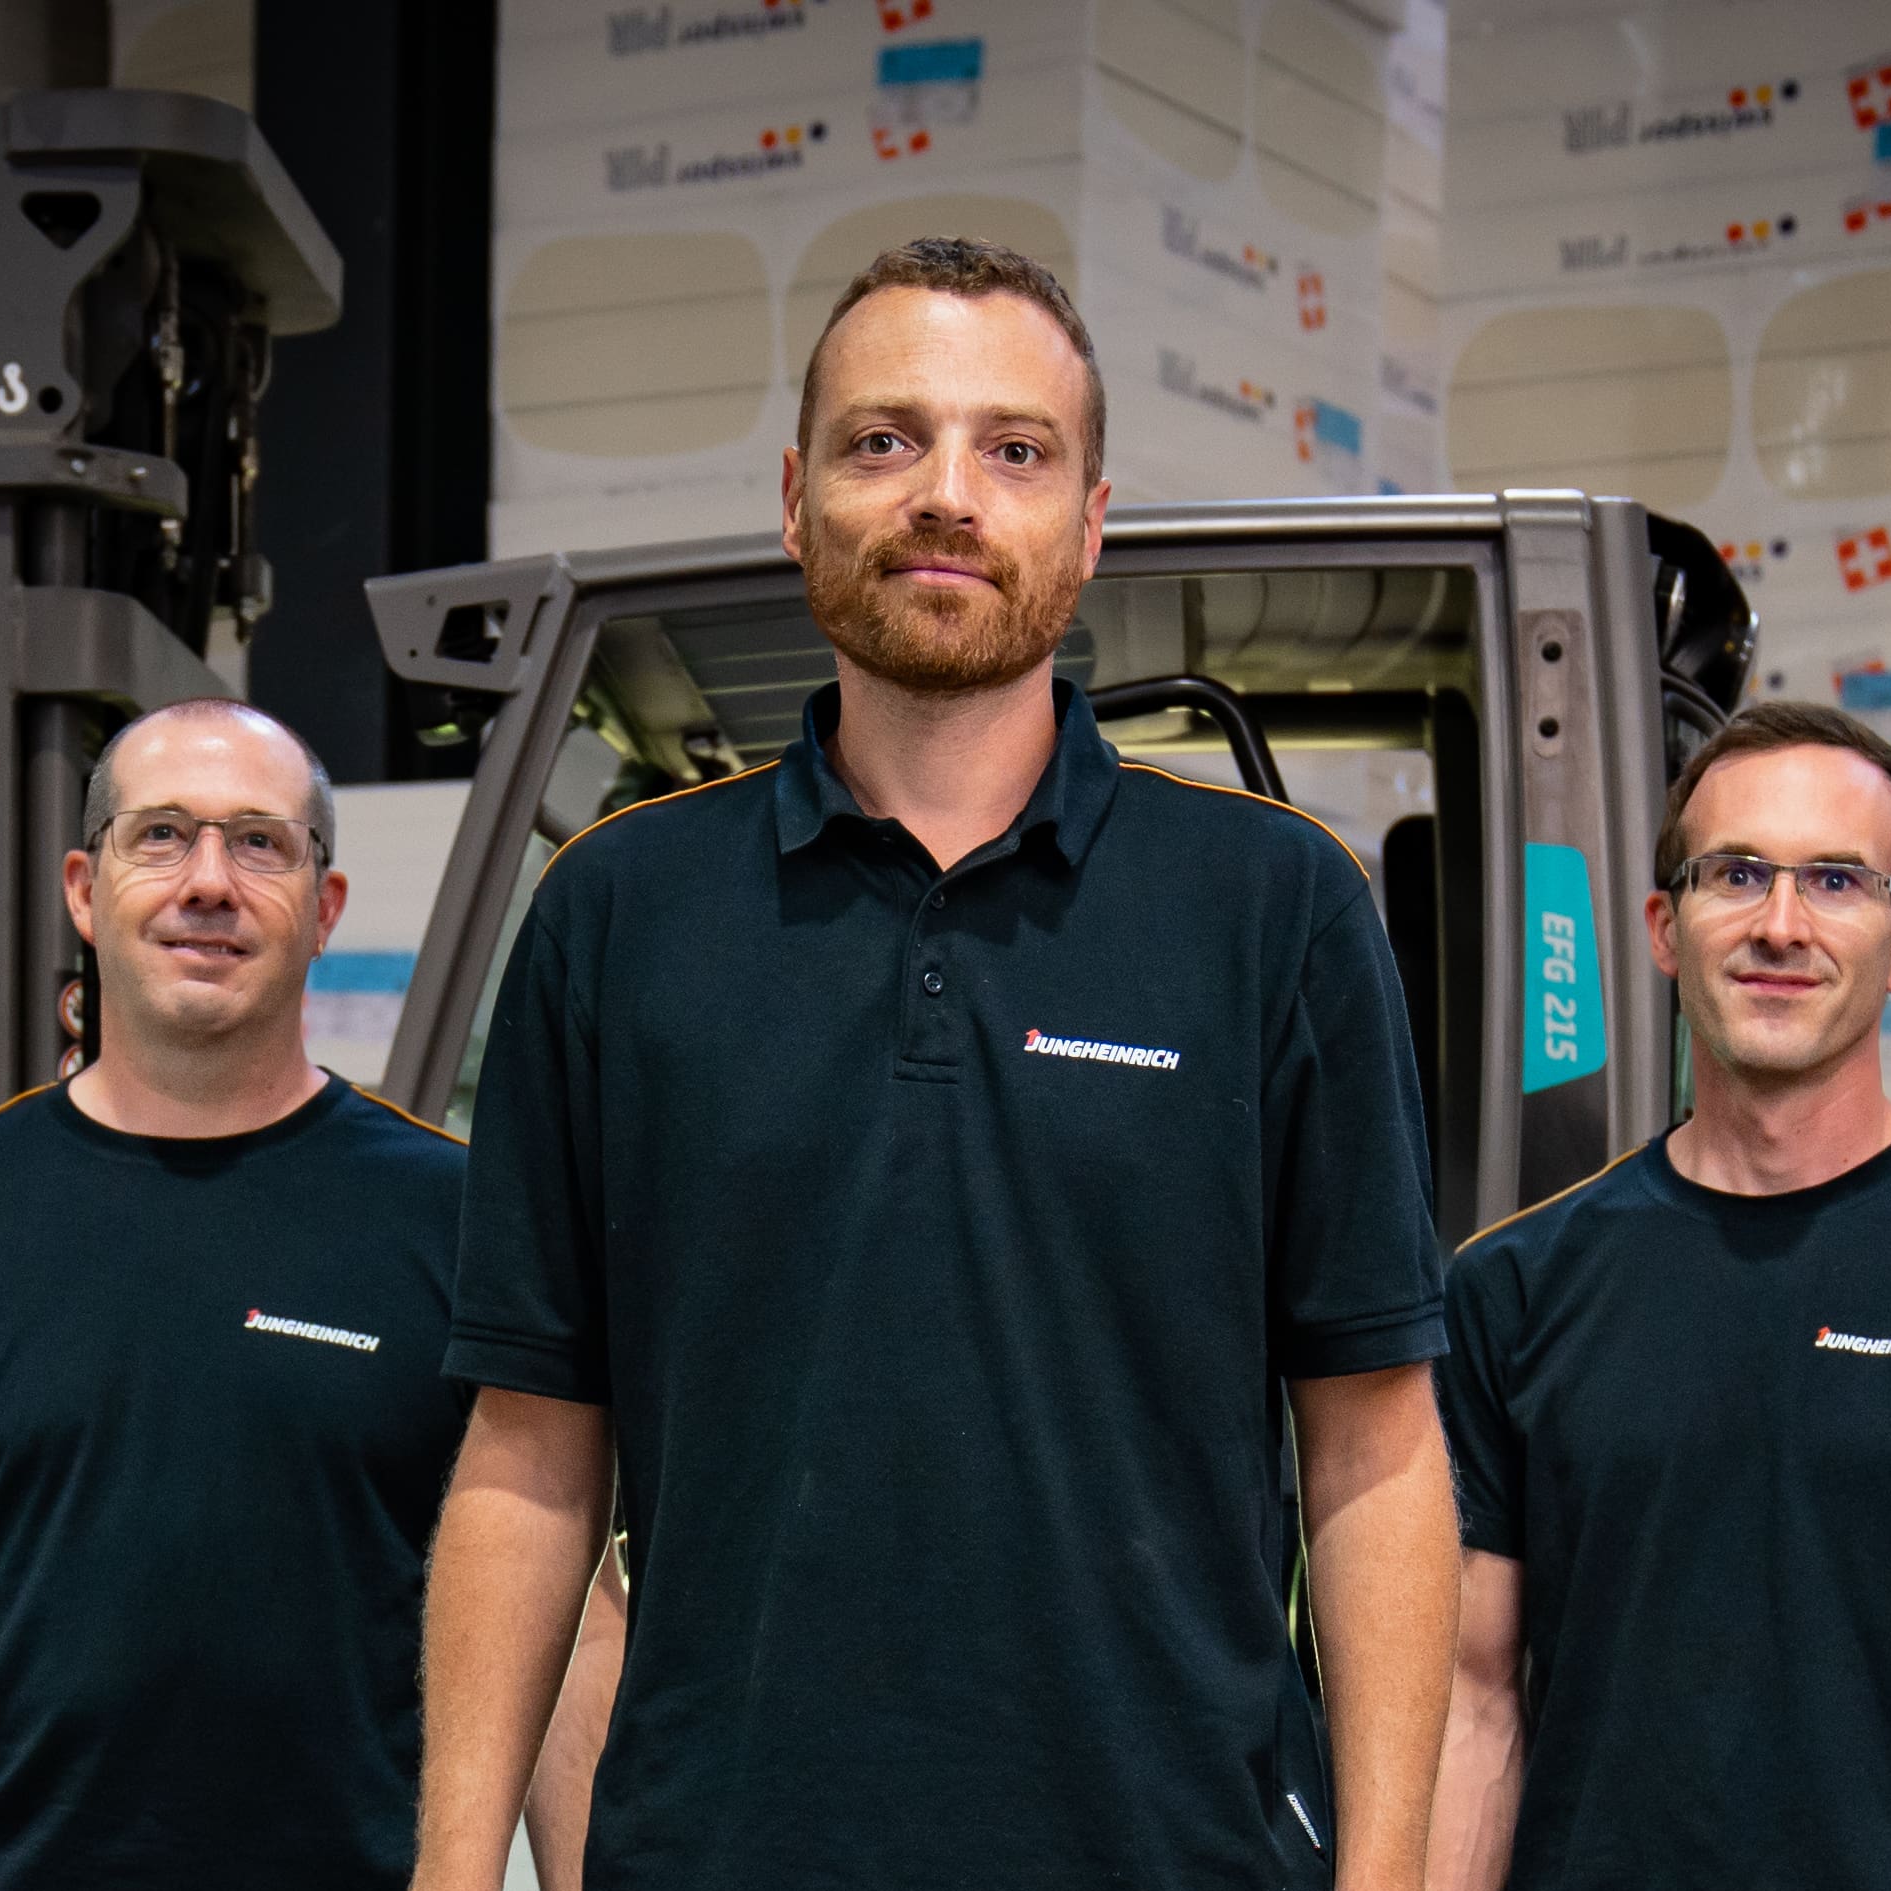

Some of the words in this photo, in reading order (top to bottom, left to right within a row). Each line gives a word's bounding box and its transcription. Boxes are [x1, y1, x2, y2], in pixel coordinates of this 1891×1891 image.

[1542, 911, 1577, 985] EFG
[1024, 1028, 1181, 1071] JUNGHEINRICH
[1544, 992, 1578, 1063] 215
[244, 1308, 381, 1352] JUNGHEINRICH
